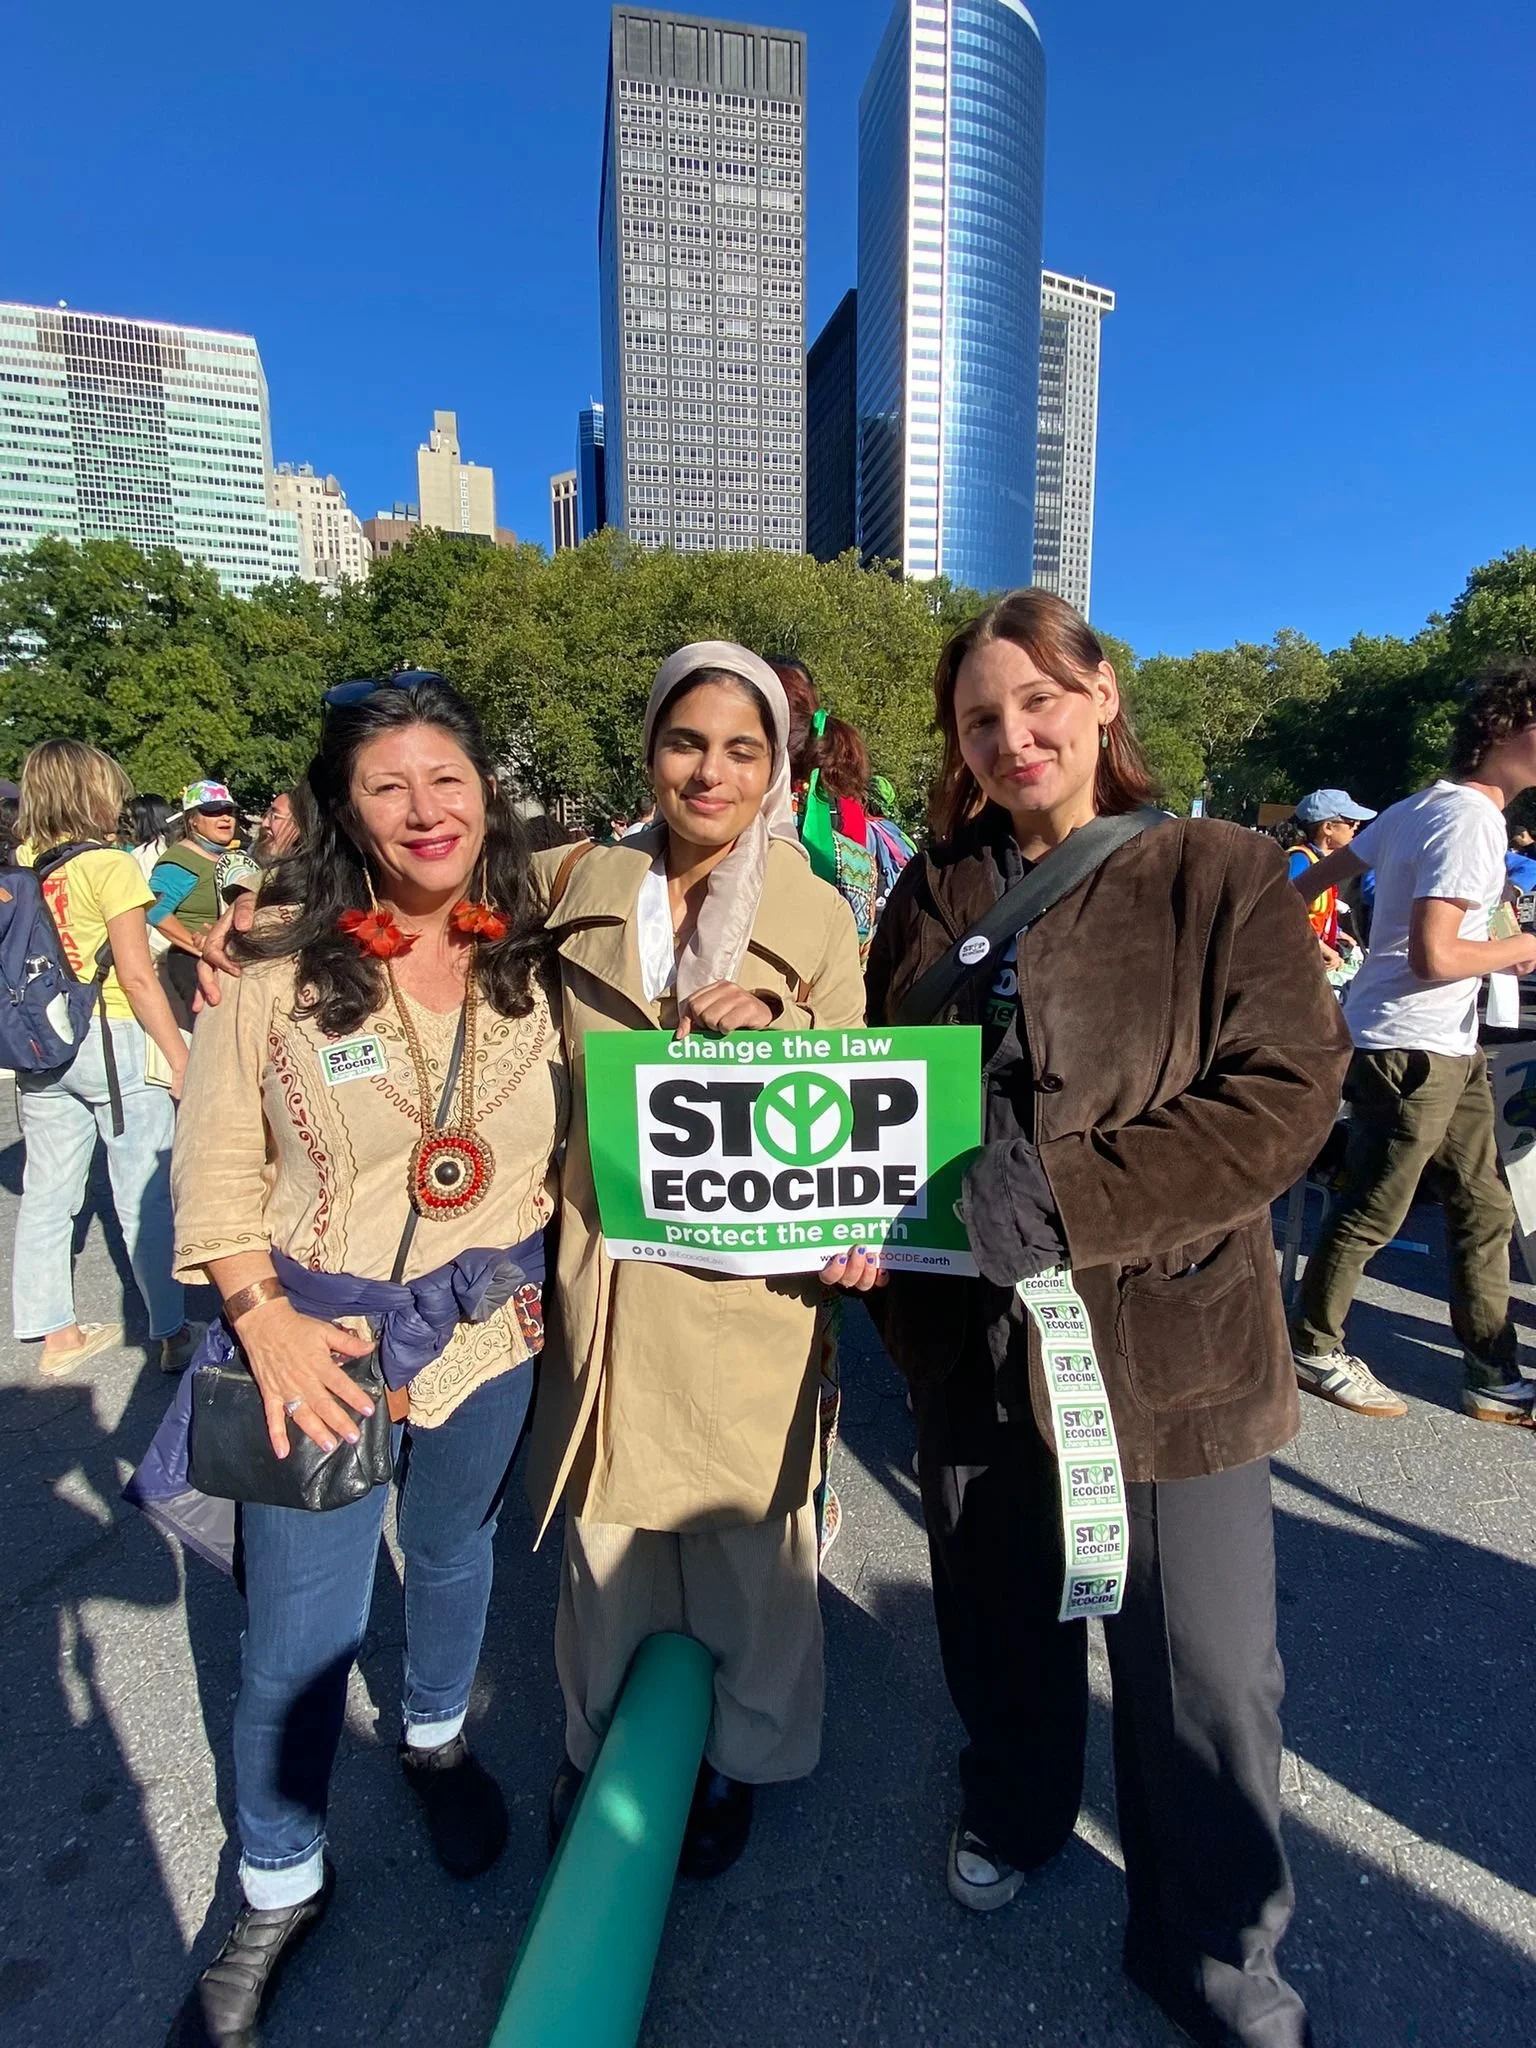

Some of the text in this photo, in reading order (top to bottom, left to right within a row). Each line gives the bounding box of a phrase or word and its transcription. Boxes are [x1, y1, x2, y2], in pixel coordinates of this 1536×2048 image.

[329, 1044, 374, 1065] STOP
[667, 1034, 893, 1063] change the law
[331, 1056, 378, 1074] ECOCIDE
[648, 1070, 920, 1167] STOP
[651, 1164, 918, 1212] ECOCIDE
[665, 1219, 908, 1246] protect the earth
[1025, 1279, 1065, 1289] ECOCIDE
[1040, 1305, 1080, 1320] STOP
[1046, 1320, 1085, 1330] ECOCIDE
[1054, 1354, 1092, 1373] STOP
[1057, 1372, 1097, 1383] ECOCIDE
[1063, 1408, 1104, 1427] STOP
[1065, 1428, 1108, 1439] ECOCIDE
[1071, 1465, 1114, 1486] STOP
[1072, 1485, 1117, 1497] ECOCIDE
[1076, 1523, 1120, 1544] STOP
[1076, 1542, 1121, 1556] ECOCIDE
[1073, 1577, 1118, 1597] STOP
[1071, 1594, 1115, 1608] ECOCIDE
